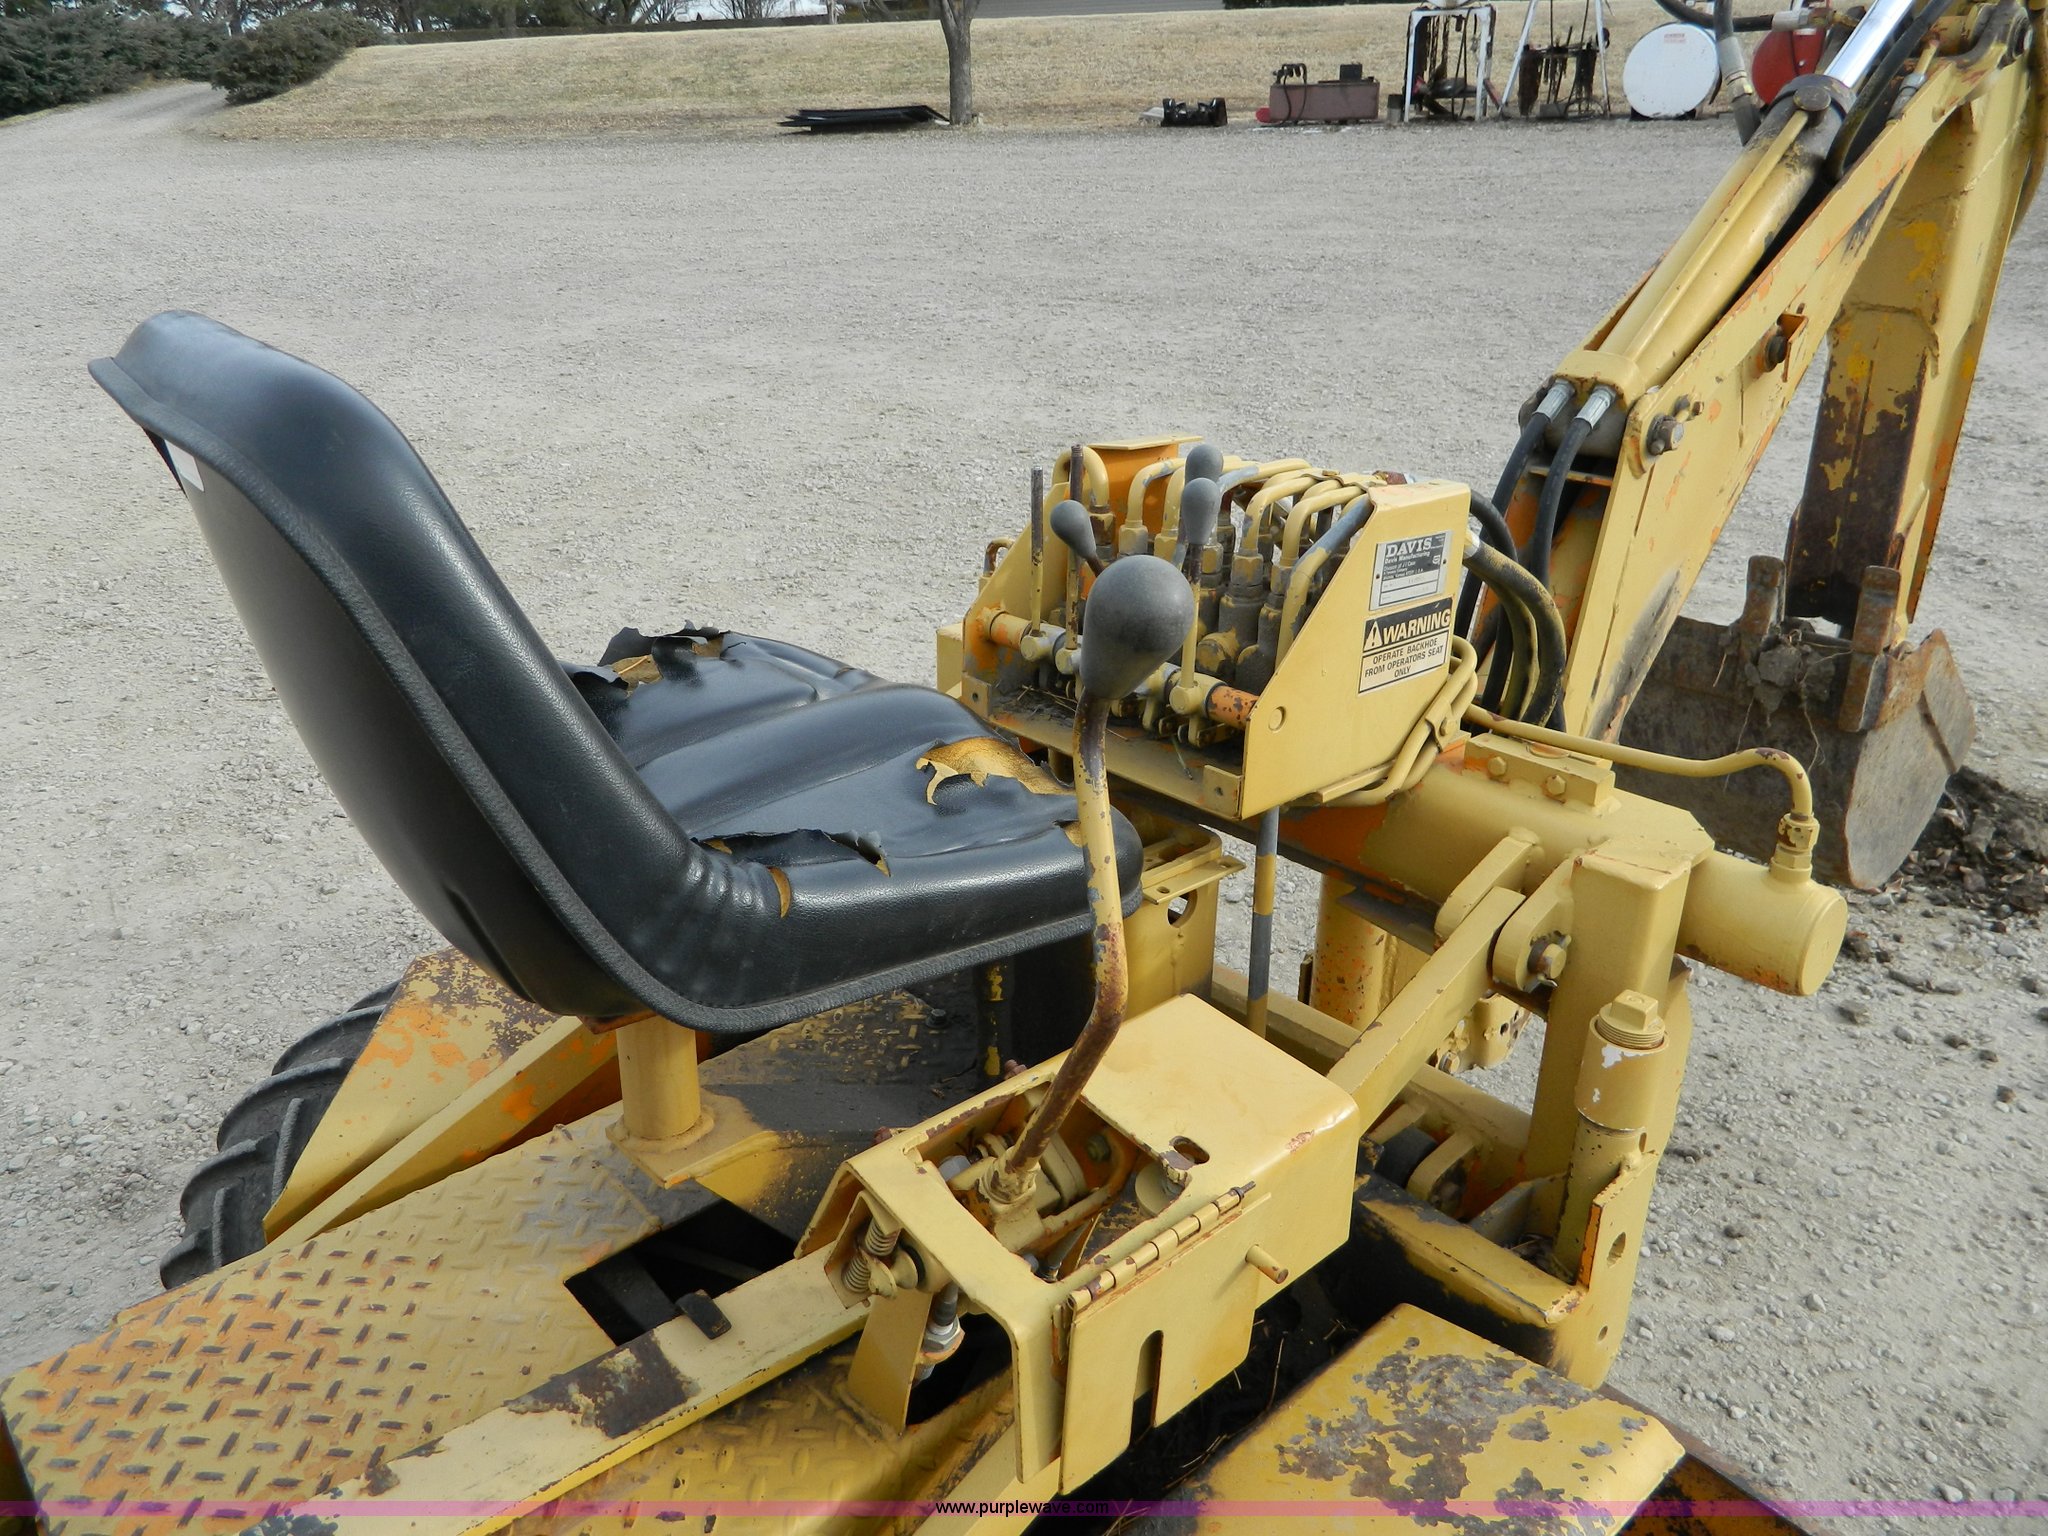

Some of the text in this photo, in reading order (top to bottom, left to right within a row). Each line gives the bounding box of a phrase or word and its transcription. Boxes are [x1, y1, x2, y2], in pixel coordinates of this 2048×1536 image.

[1386, 537, 1432, 557] DAVIS
[1383, 608, 1451, 645] WARNING
[1365, 645, 1444, 677] FROM OPERATORS SEAT
[1373, 637, 1438, 664] OPERATE BACKHOE
[1394, 665, 1411, 678] ONLY
